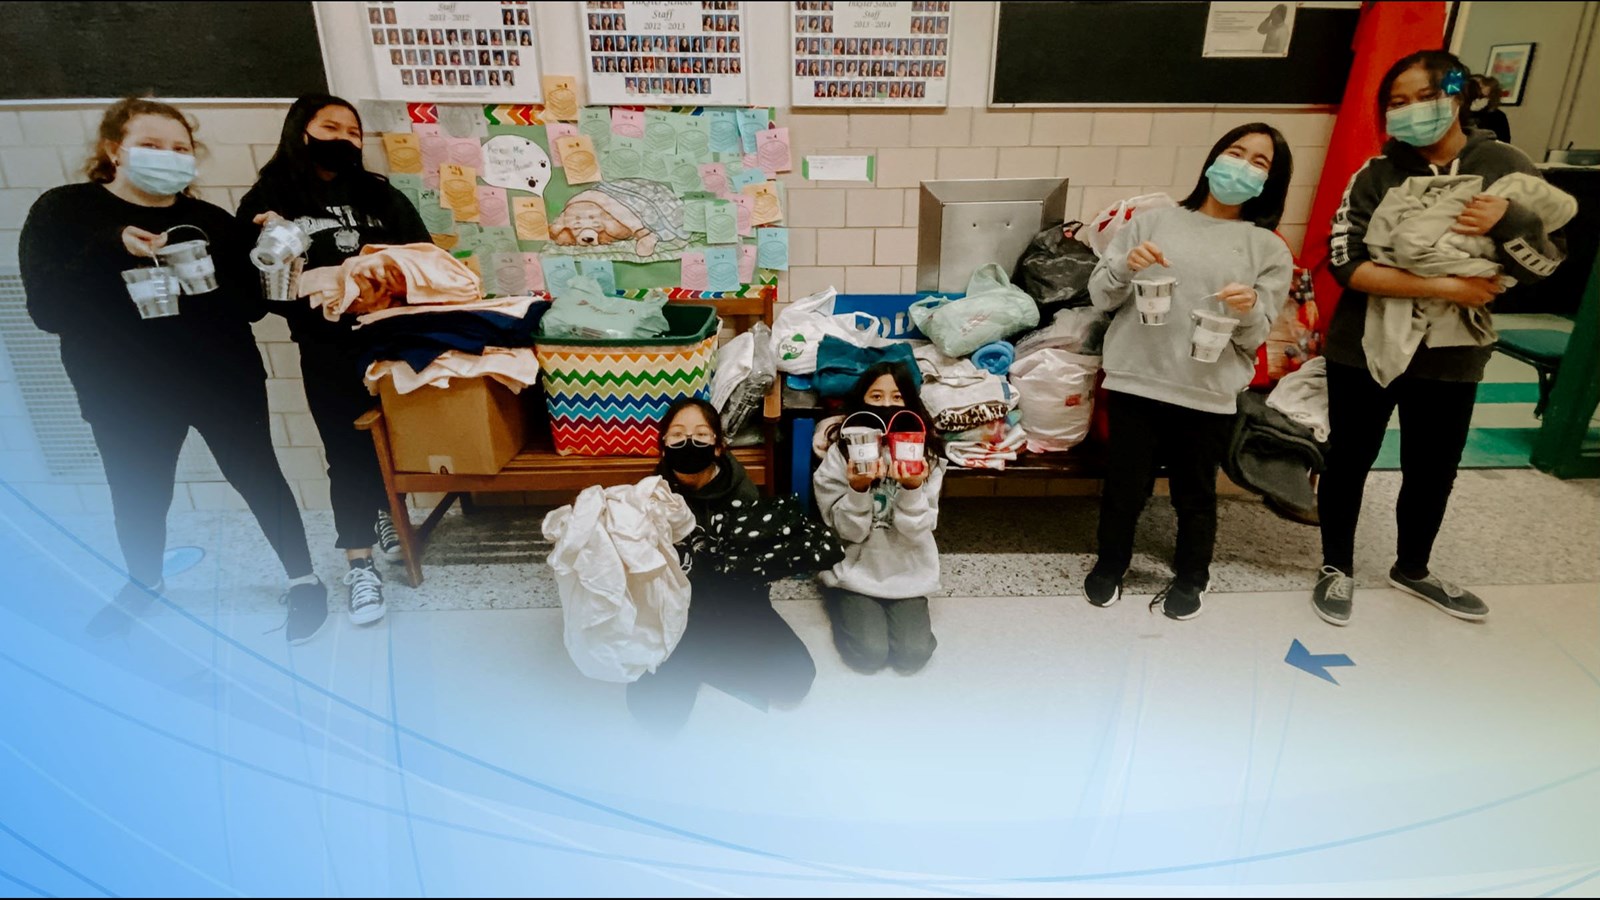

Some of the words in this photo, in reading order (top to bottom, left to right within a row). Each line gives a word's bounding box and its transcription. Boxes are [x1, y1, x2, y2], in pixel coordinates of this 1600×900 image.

[652, 9, 674, 21] Staff
[862, 10, 880, 20] Staff
[644, 22, 661, 30] 2012
[667, 22, 686, 30] 2013
[781, 343, 798, 353] eco
